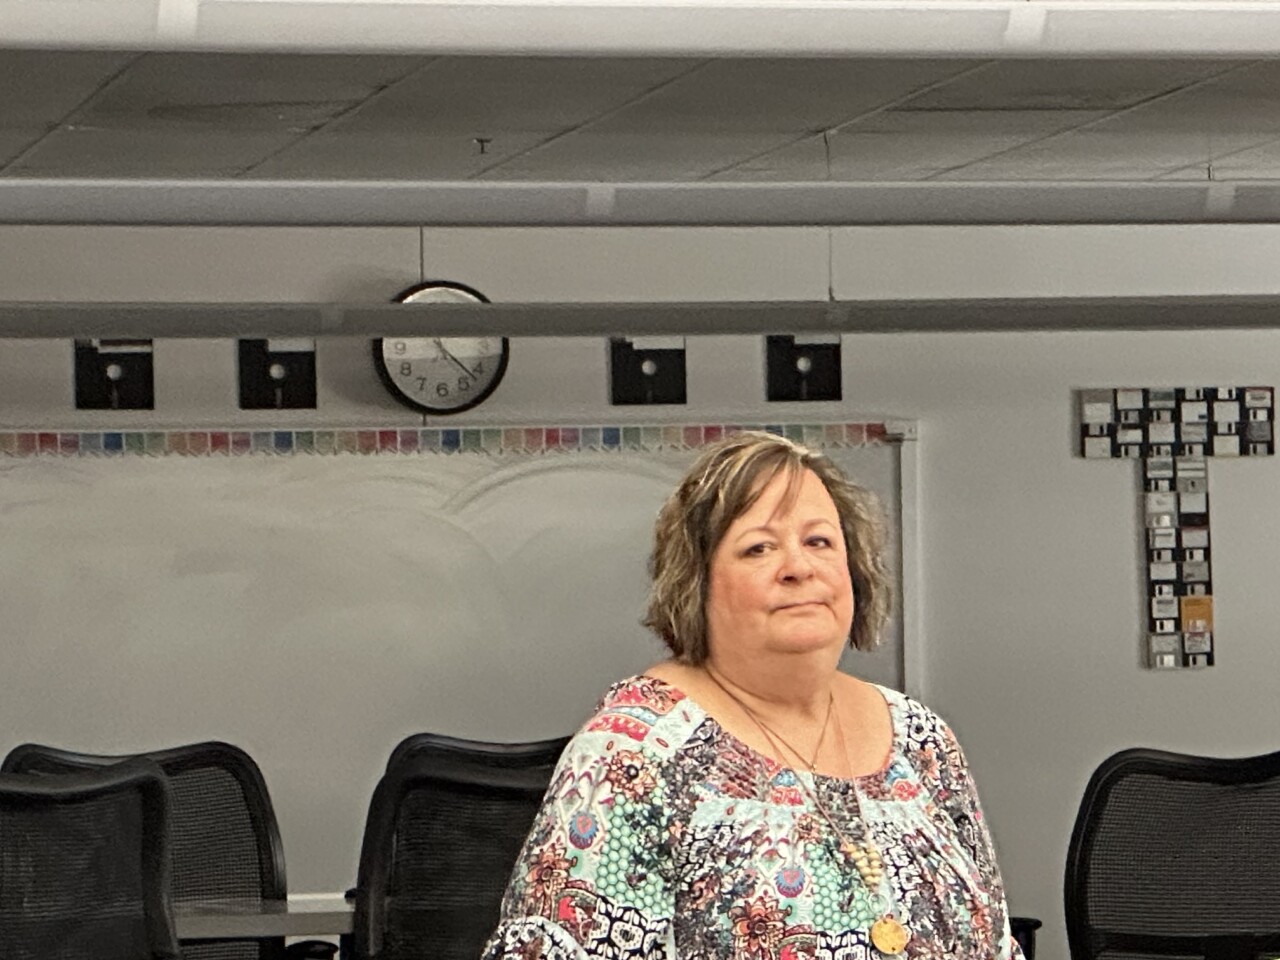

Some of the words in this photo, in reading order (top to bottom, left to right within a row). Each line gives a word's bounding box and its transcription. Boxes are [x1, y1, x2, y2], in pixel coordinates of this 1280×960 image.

[394, 342, 406, 355] 9
[400, 362, 412, 377] 8
[472, 362, 484, 375] 4
[415, 377, 427, 391] 7
[436, 383, 449, 397] 6
[458, 376, 470, 391] 5
